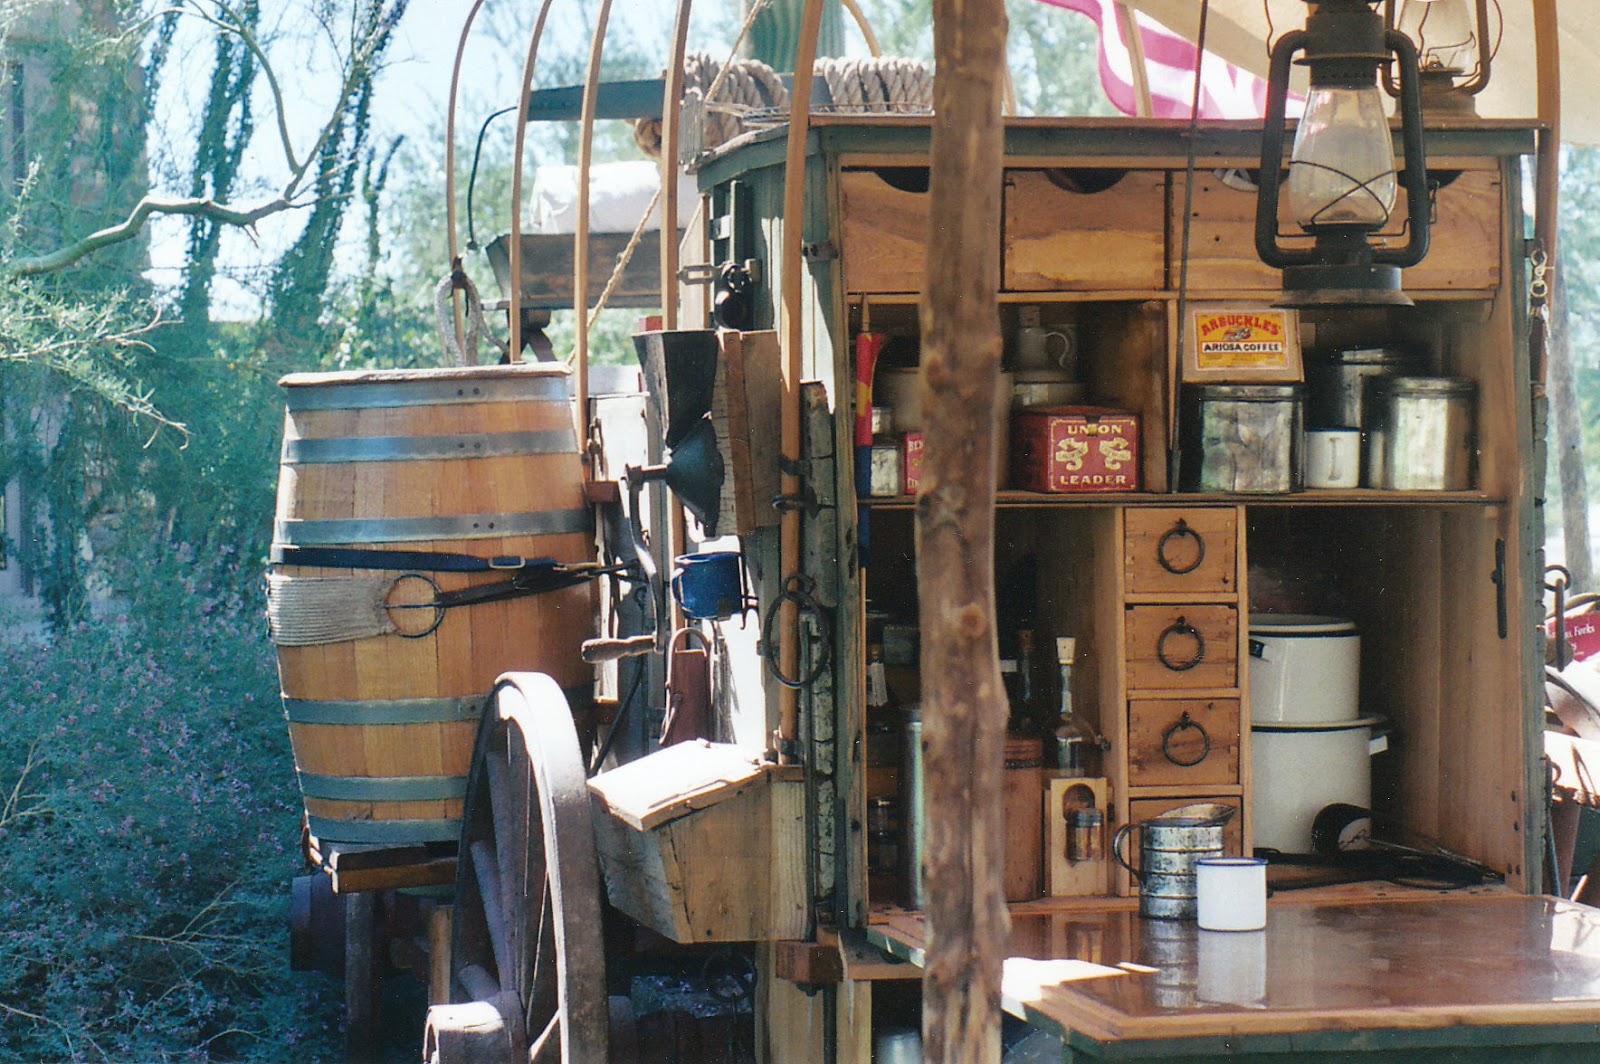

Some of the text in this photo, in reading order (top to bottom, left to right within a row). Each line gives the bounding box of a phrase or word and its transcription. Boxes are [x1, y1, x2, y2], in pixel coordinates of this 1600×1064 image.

[1204, 343, 1279, 352] ARIOSA COFFEE
[1067, 425, 1122, 435] UNON
[1060, 475, 1126, 485] LEADER
